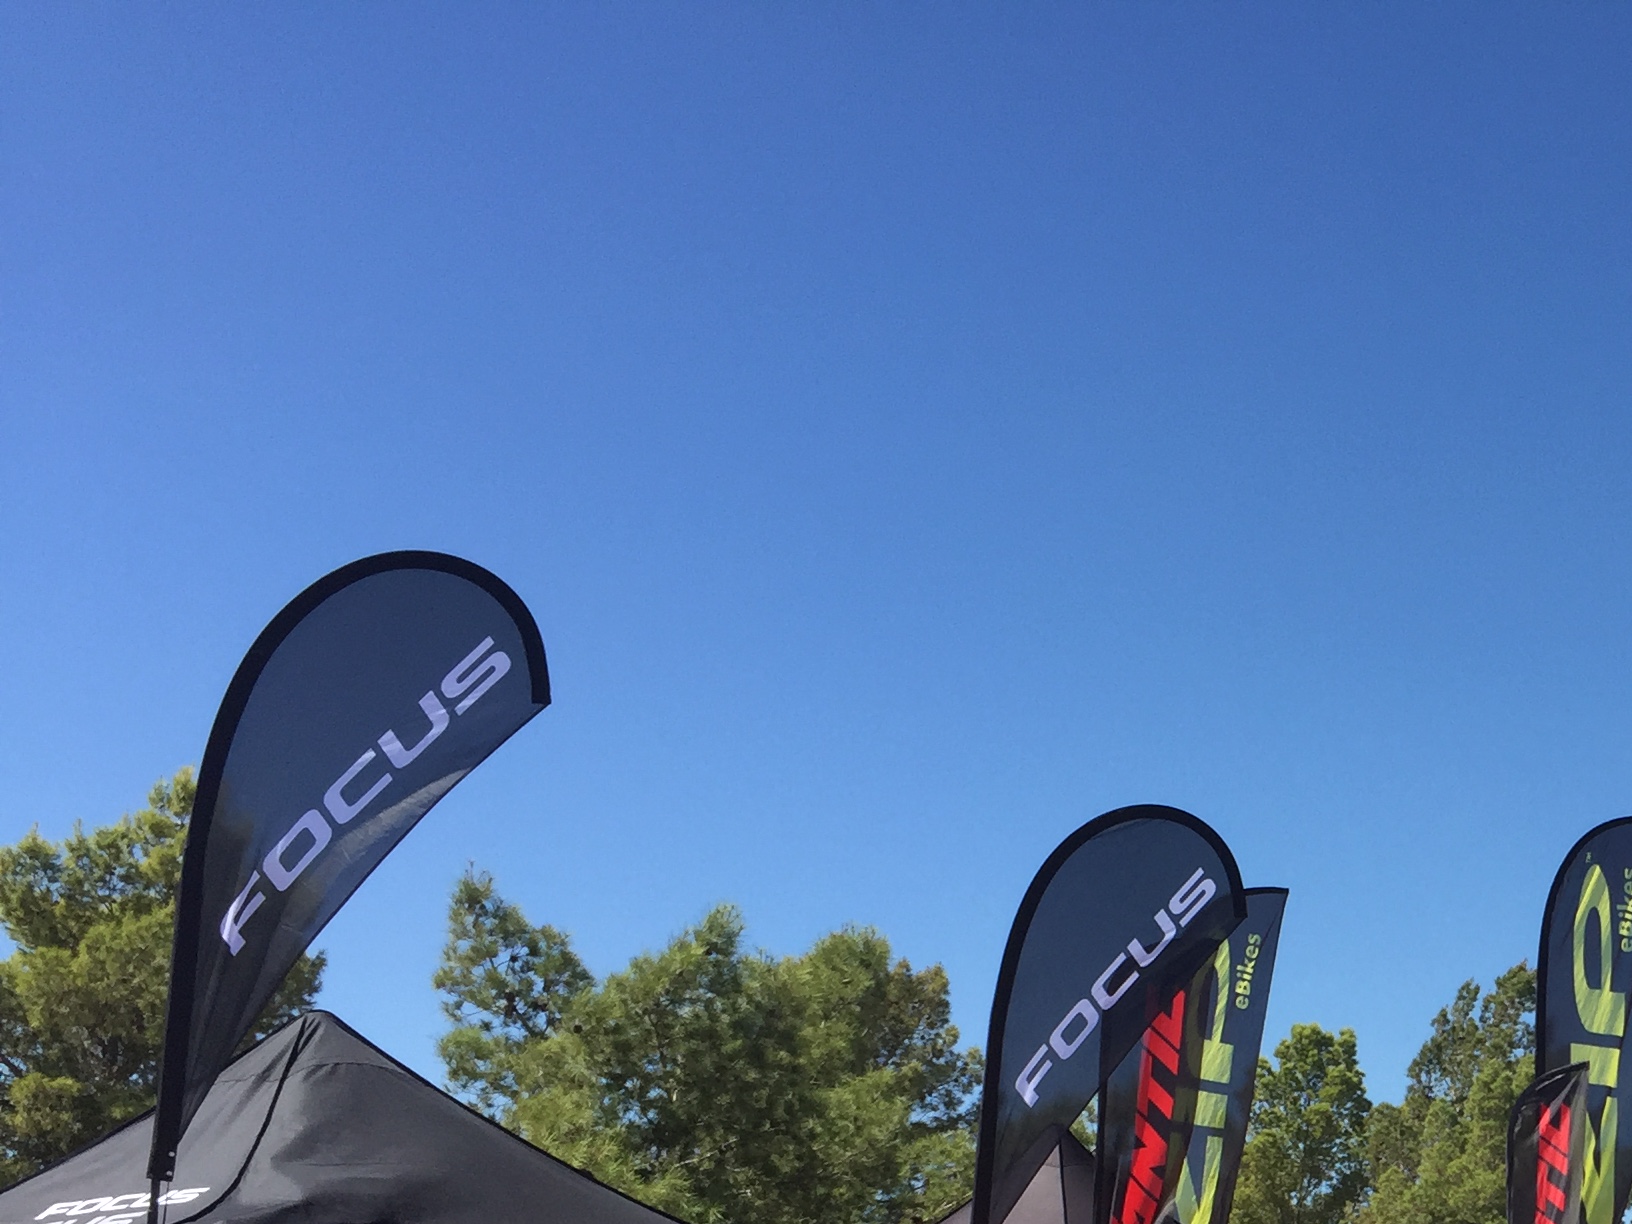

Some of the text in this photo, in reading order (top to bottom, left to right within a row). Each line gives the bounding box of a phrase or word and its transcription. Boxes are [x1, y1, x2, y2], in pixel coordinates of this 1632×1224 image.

[219, 636, 512, 956] FOCUS
[1015, 867, 1217, 1108] FOCUS
[1234, 932, 1262, 1010] eBikes
[35, 1187, 211, 1221] FOCUS
